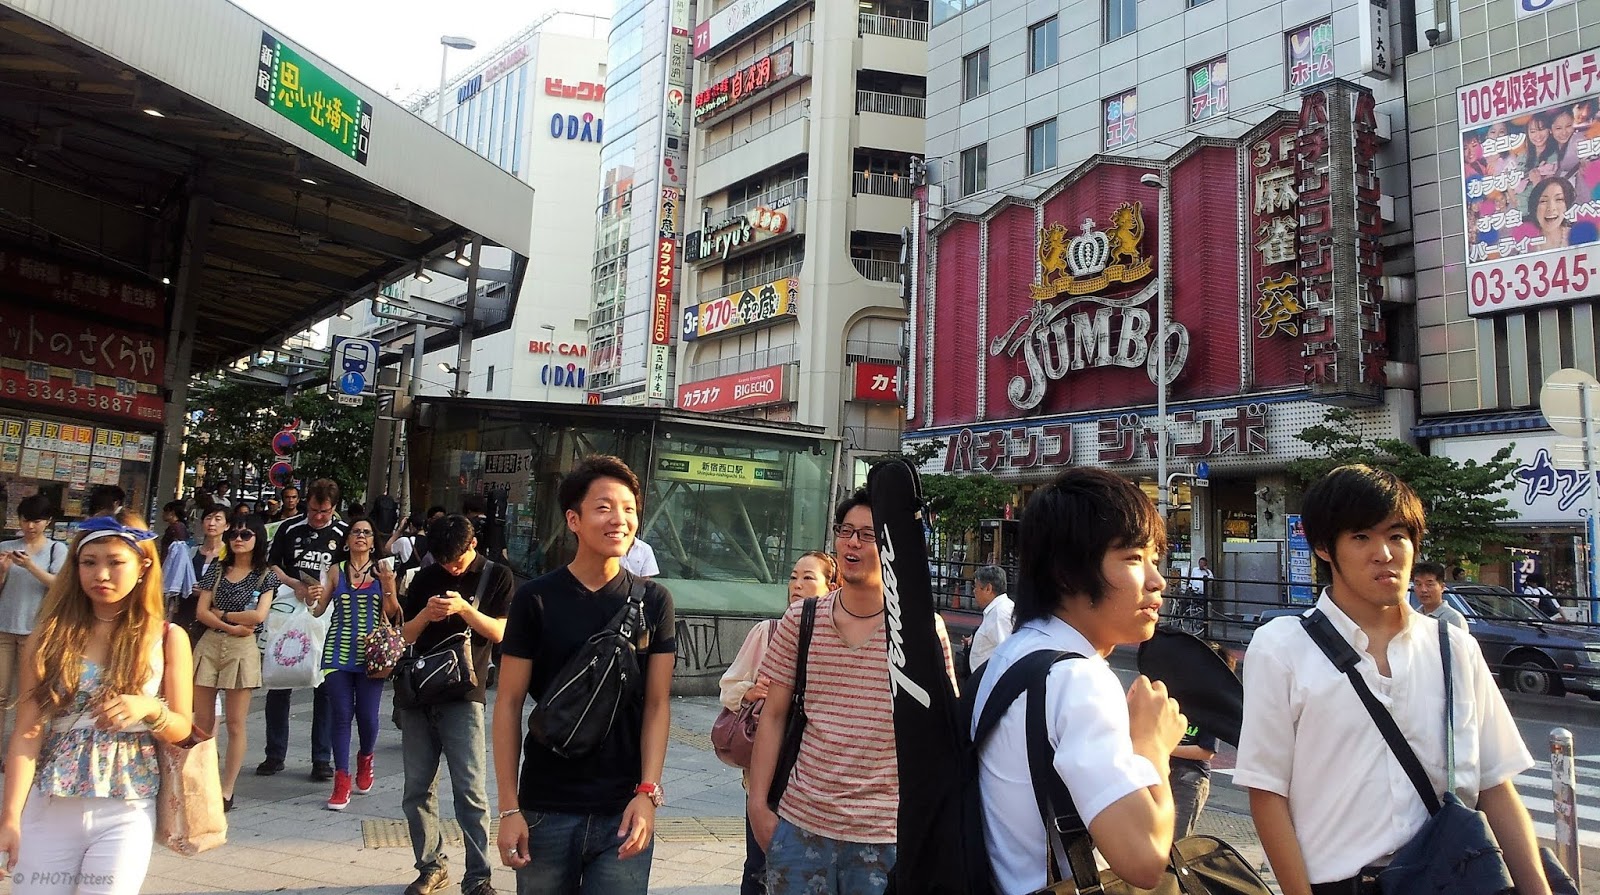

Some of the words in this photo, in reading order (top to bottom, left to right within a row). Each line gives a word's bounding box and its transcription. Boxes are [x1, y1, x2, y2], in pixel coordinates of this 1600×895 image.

[697, 31, 708, 48] 7F
[257, 44, 274, 92] 新宿
[1291, 53, 1334, 86] ホーム
[278, 61, 354, 144] 思い出横丁
[1192, 86, 1227, 119] アール
[1461, 53, 1600, 125] 100名収容大パーテ
[358, 112, 371, 154] 西口
[1107, 116, 1136, 148] エス
[1482, 132, 1527, 158] 合コン
[1253, 133, 1297, 168] 3F
[662, 189, 677, 199] 270
[1467, 170, 1525, 198] カラオケ
[1253, 166, 1299, 267] 麻雀
[1477, 209, 1523, 233] オフ会
[657, 241, 672, 288] カラオケ
[1470, 235, 1546, 262] パーティー
[1471, 253, 1597, 307] 03-3345-
[683, 311, 698, 334] 3F
[0, 314, 155, 376] ットのさくらや
[990, 277, 1189, 410] JUMBO
[0, 378, 133, 413] 3-3343-5887
[683, 387, 720, 406] カラオケ
[943, 428, 1073, 473] パチンコ
[1097, 402, 1268, 463] ジャンボ
[701, 461, 744, 474] 新宿西口駅
[881, 523, 931, 713] Fender
